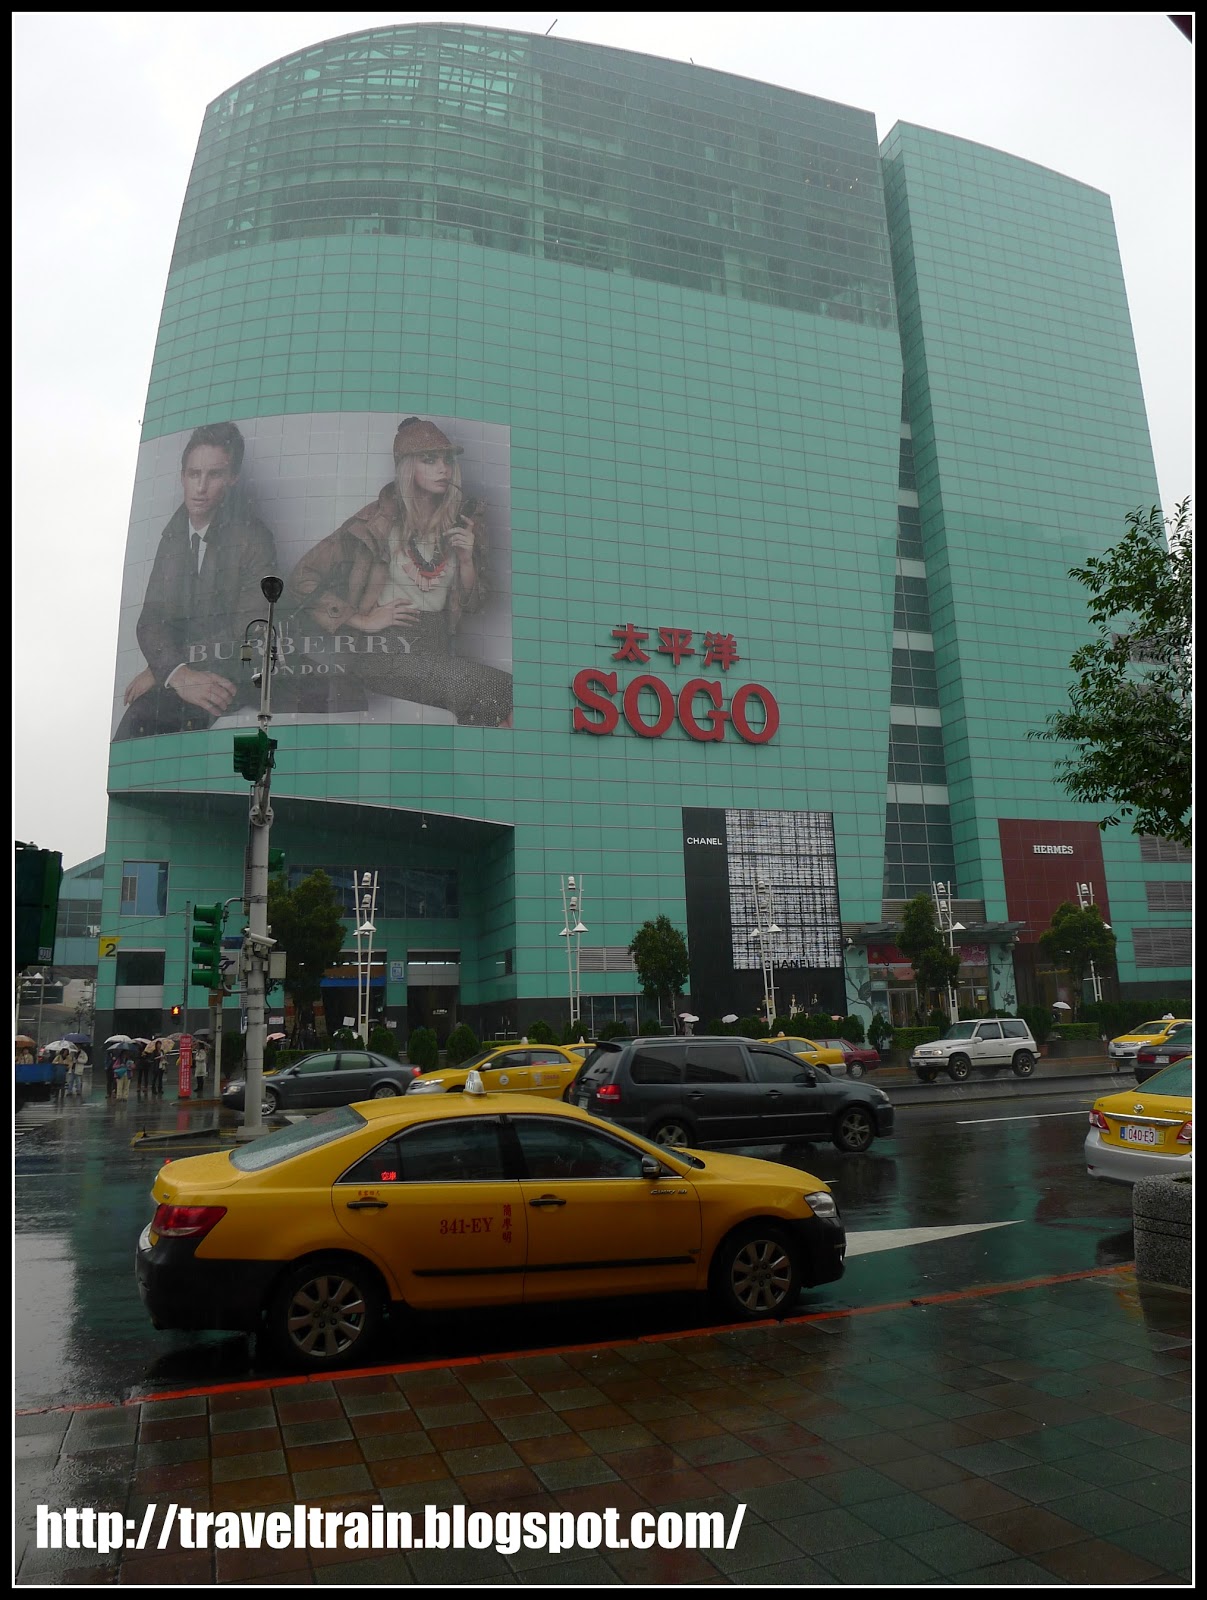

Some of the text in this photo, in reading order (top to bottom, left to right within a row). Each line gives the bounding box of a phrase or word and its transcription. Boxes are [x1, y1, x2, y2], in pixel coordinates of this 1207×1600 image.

[188, 635, 422, 664] BURBERRY
[611, 622, 740, 671] 太平洋
[572, 668, 780, 744] SOGO
[686, 836, 723, 846] CHANEL
[105, 943, 116, 957] 2
[440, 1216, 493, 1235] 341-EY
